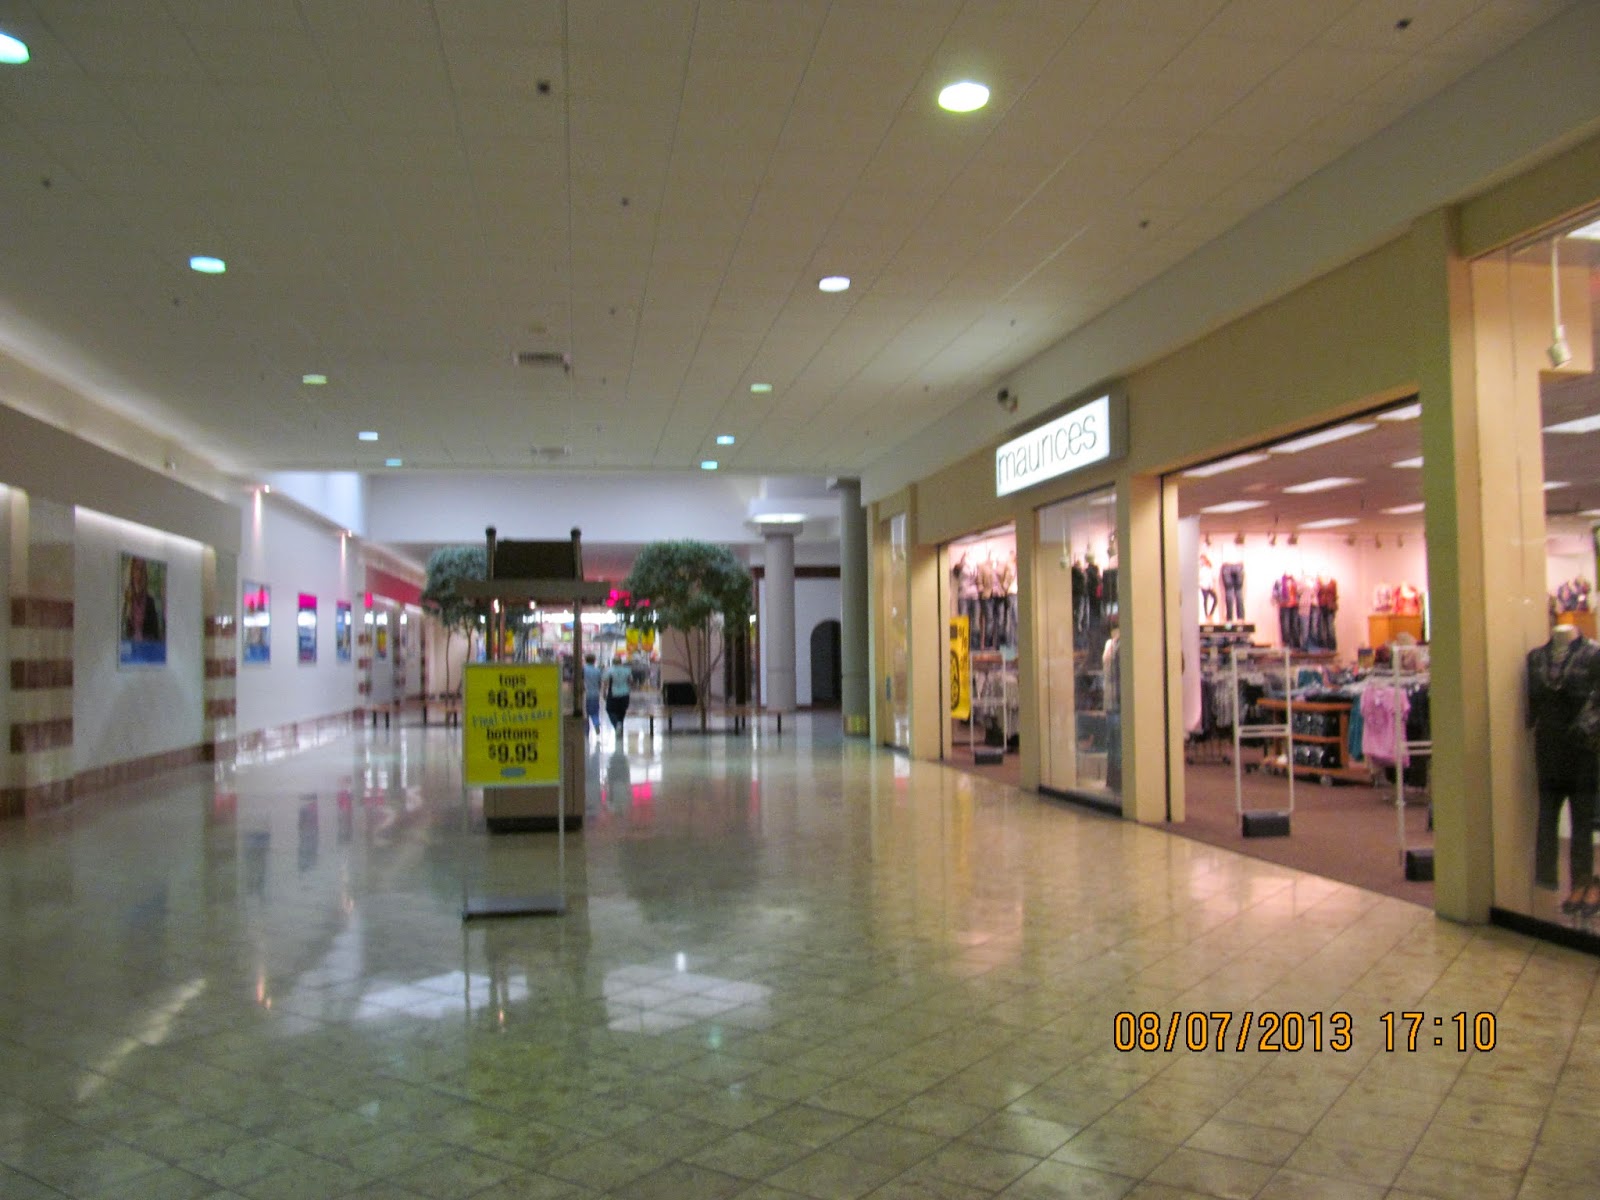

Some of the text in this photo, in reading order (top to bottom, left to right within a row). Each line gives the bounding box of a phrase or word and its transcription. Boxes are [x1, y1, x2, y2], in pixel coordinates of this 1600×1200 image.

[997, 413, 1098, 486] maurices
[499, 674, 527, 689] tops
[488, 690, 538, 709] $6.95
[486, 728, 539, 741] bottoms
[488, 744, 539, 764] $9.95
